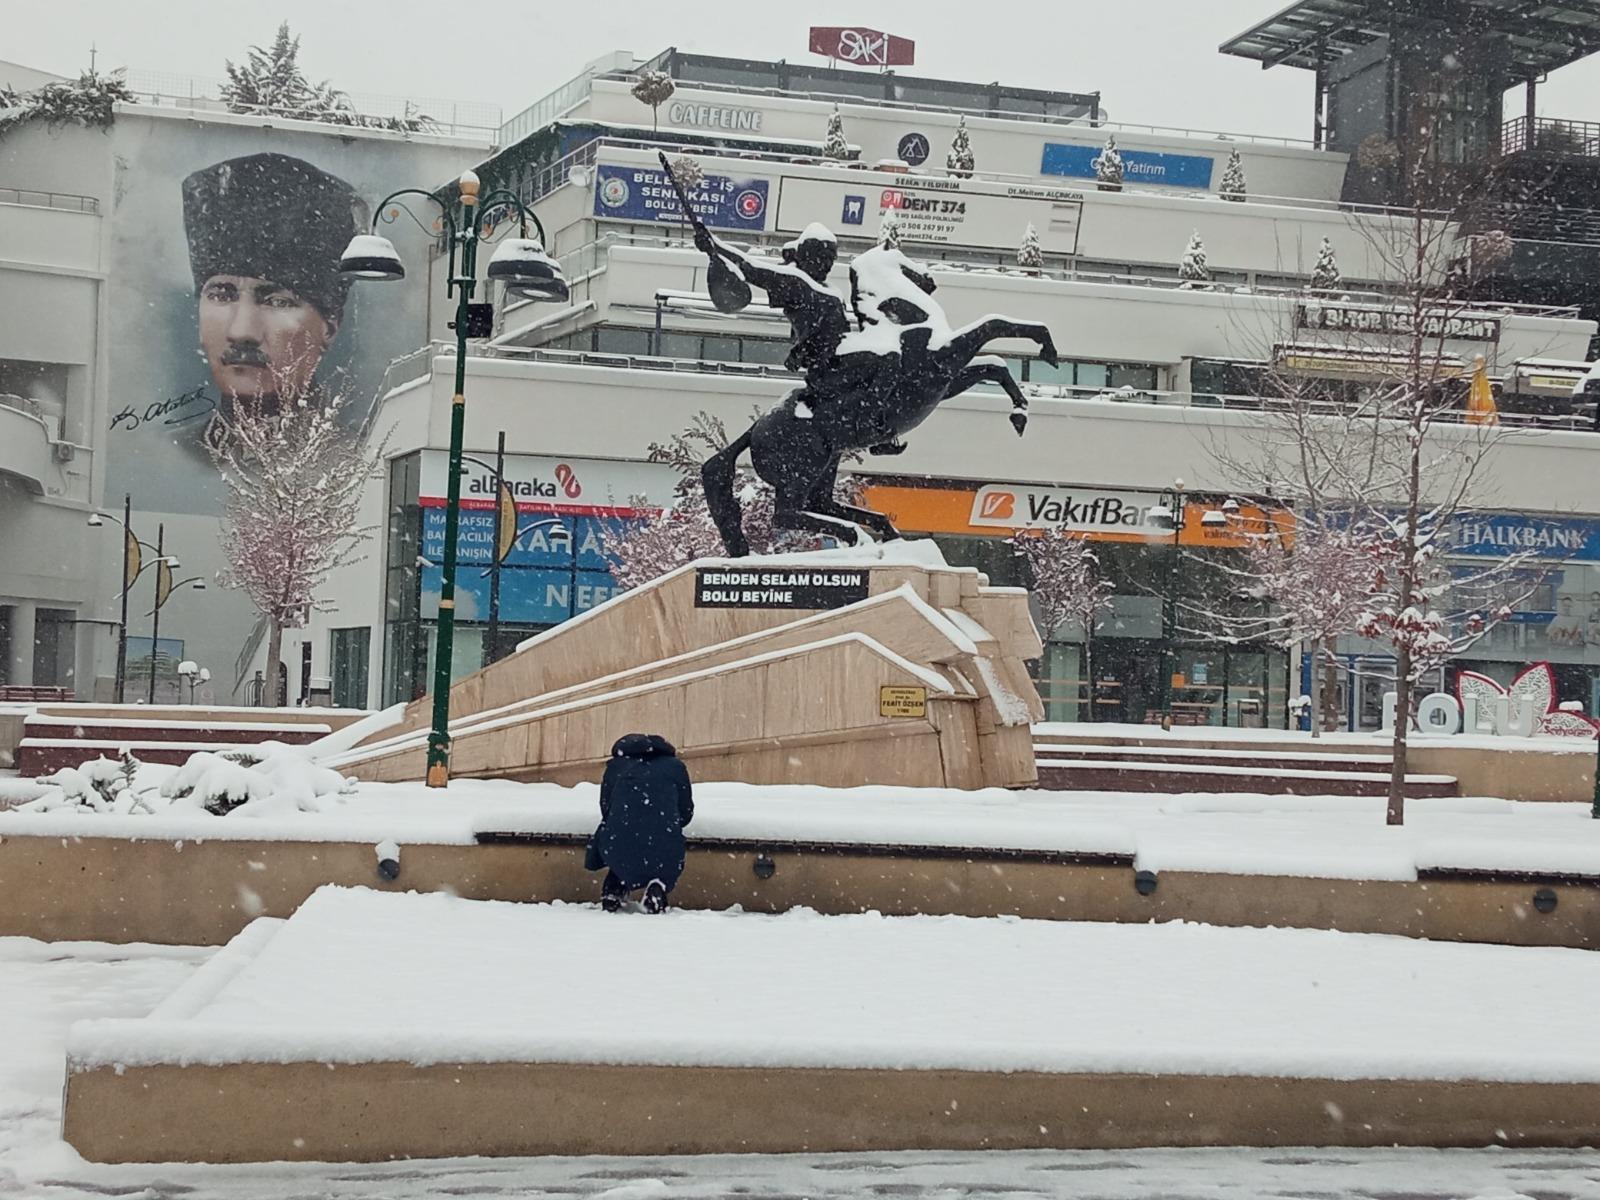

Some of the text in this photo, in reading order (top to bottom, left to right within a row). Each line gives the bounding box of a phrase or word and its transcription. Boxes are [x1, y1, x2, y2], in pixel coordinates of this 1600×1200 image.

[669, 103, 762, 131] CAFFEINE
[641, 187, 725, 203] SENDKASI
[645, 200, 718, 215] BOLU BESİ
[941, 200, 966, 214] 374
[900, 233, 947, 241] w.dent374.com
[469, 474, 557, 497] alBaraka
[1027, 494, 1156, 526] VakıfBan
[430, 514, 494, 528] MAAFSIZ
[1462, 523, 1587, 549] HALKBANK
[703, 573, 861, 587] BENDEN SELAM OLSUN
[702, 588, 793, 603] BOLU BEYİNE
[1382, 692, 1534, 737] BOLU
